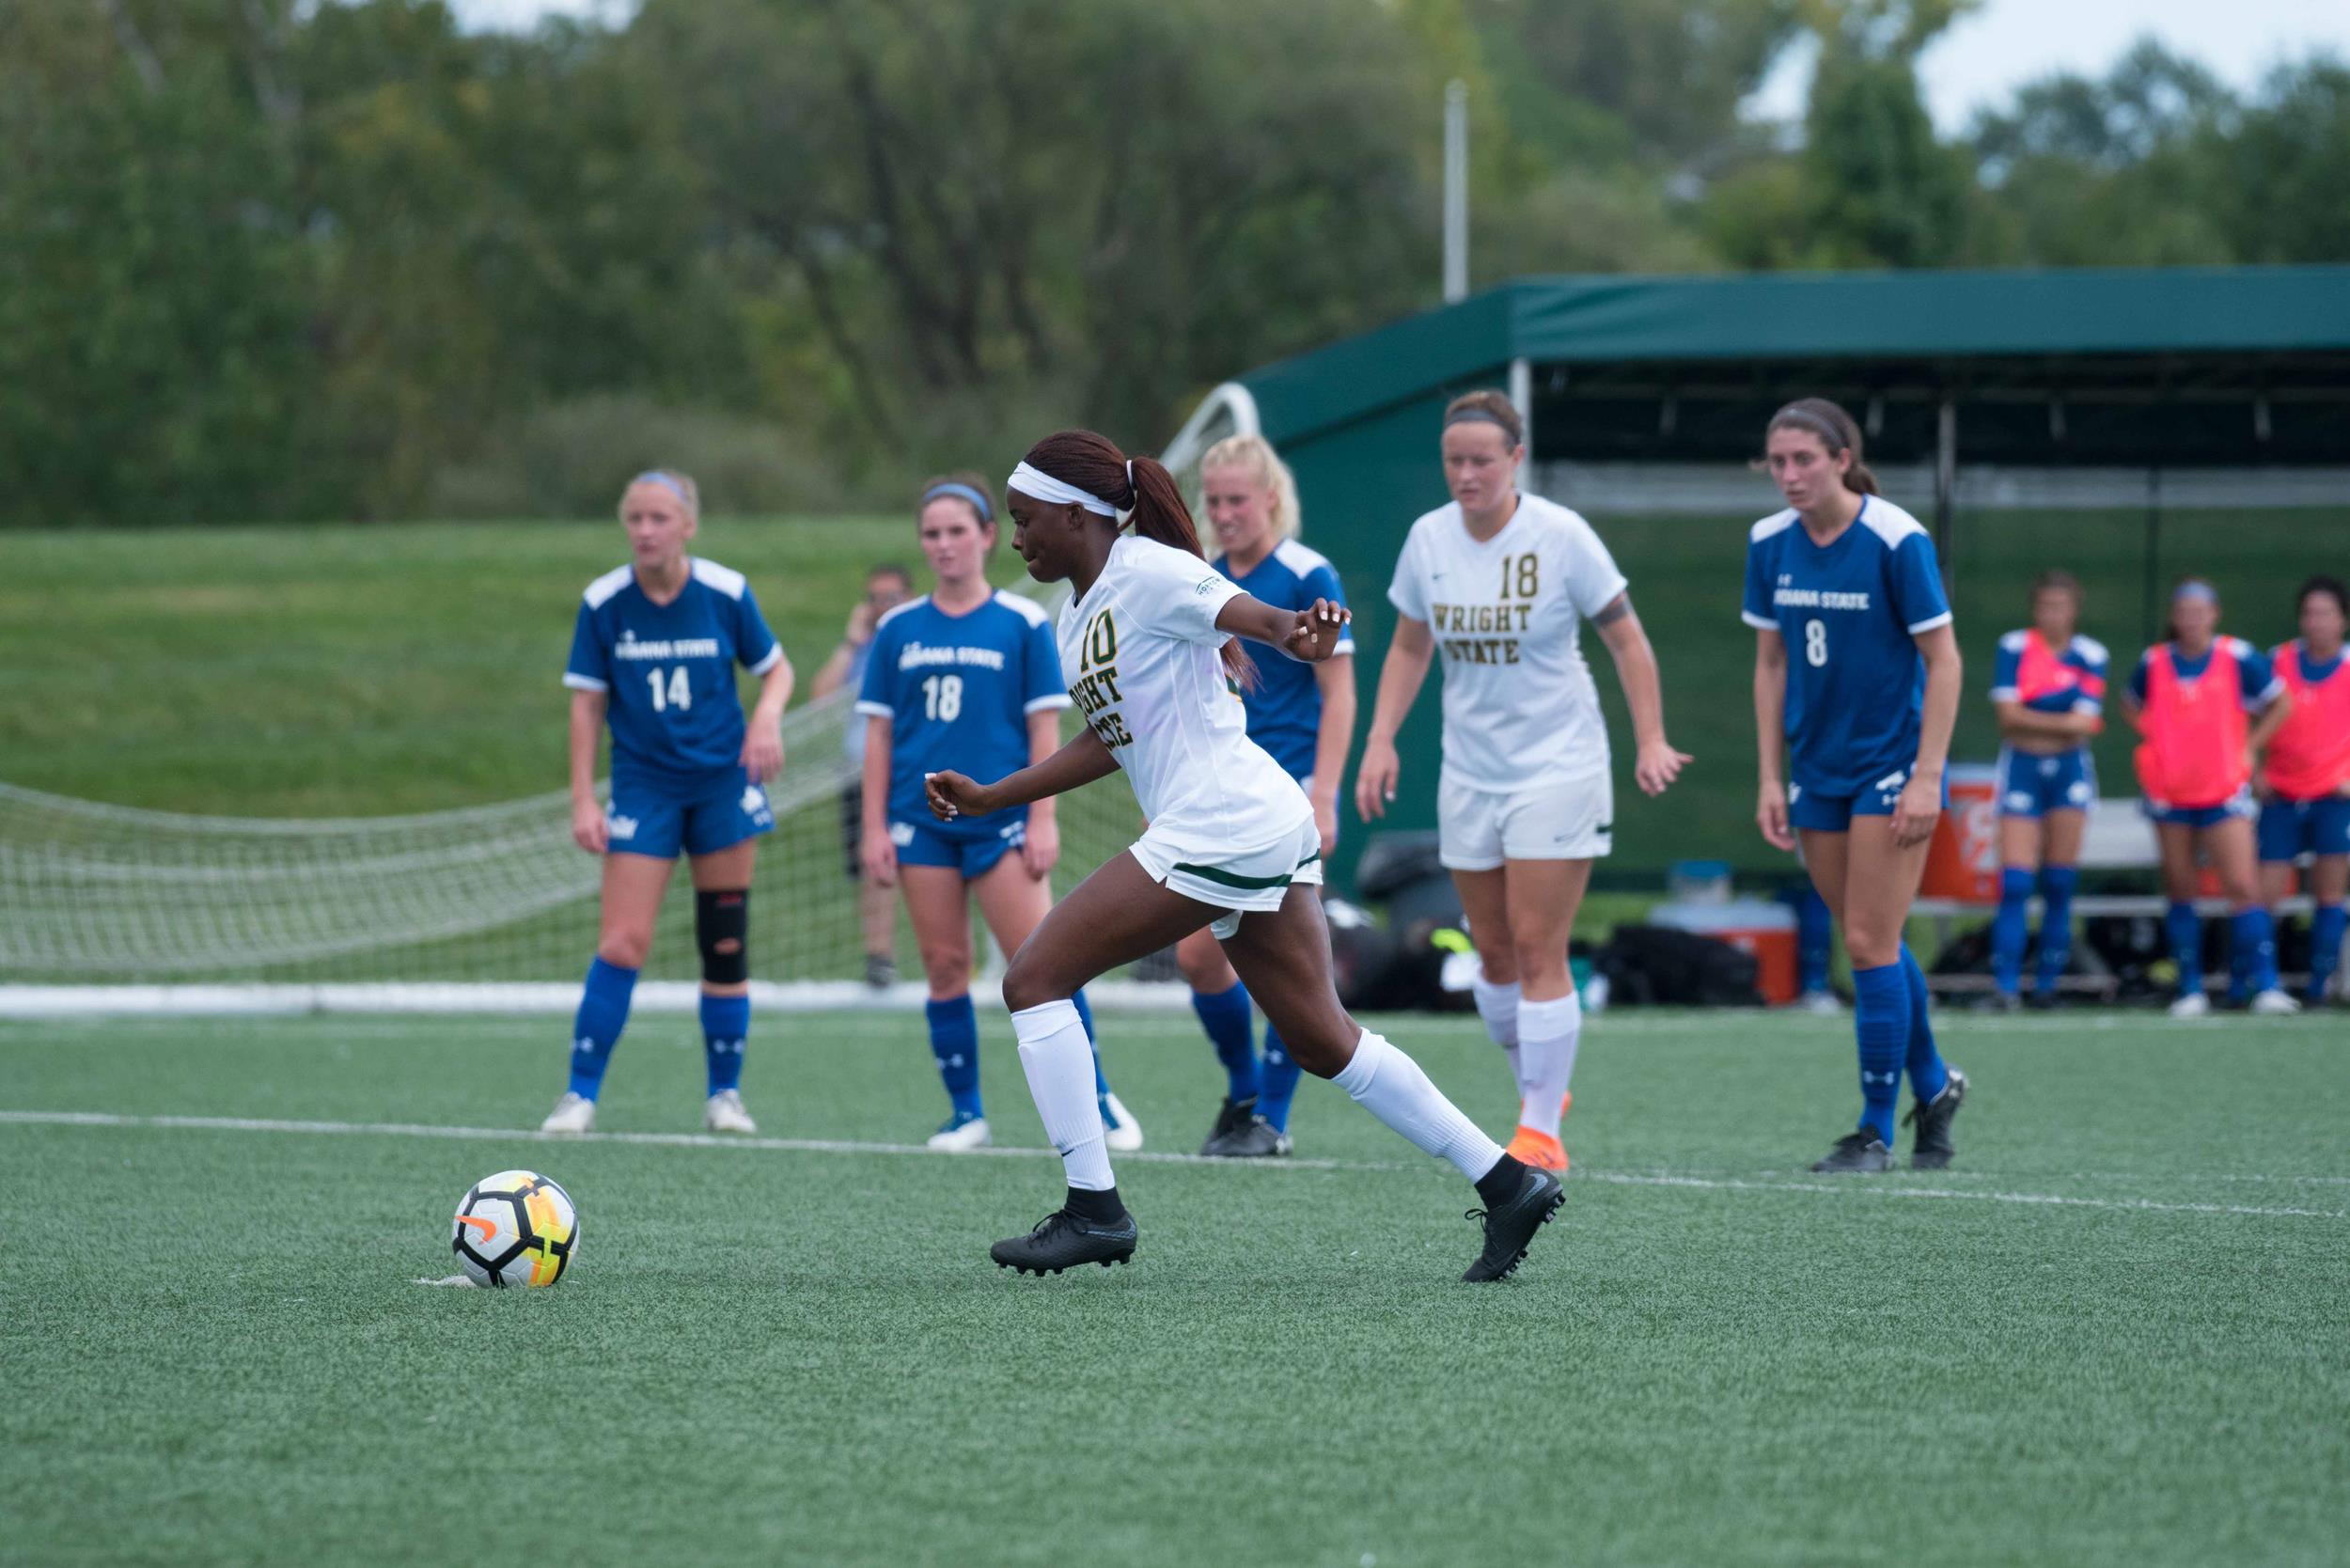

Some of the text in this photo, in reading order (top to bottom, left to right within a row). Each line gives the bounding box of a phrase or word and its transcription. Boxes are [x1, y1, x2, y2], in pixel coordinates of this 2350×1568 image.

[1500, 553, 1538, 599] 18
[1433, 604, 1531, 632] WRIGHT
[1821, 591, 1870, 610] STATE
[673, 638, 719, 659] STATE
[956, 646, 1004, 671] STATE
[1081, 607, 1117, 674] 10
[1444, 638, 1520, 665] STATE
[1806, 619, 1828, 667] 8
[647, 666, 692, 713] 14
[922, 675, 964, 723] 18
